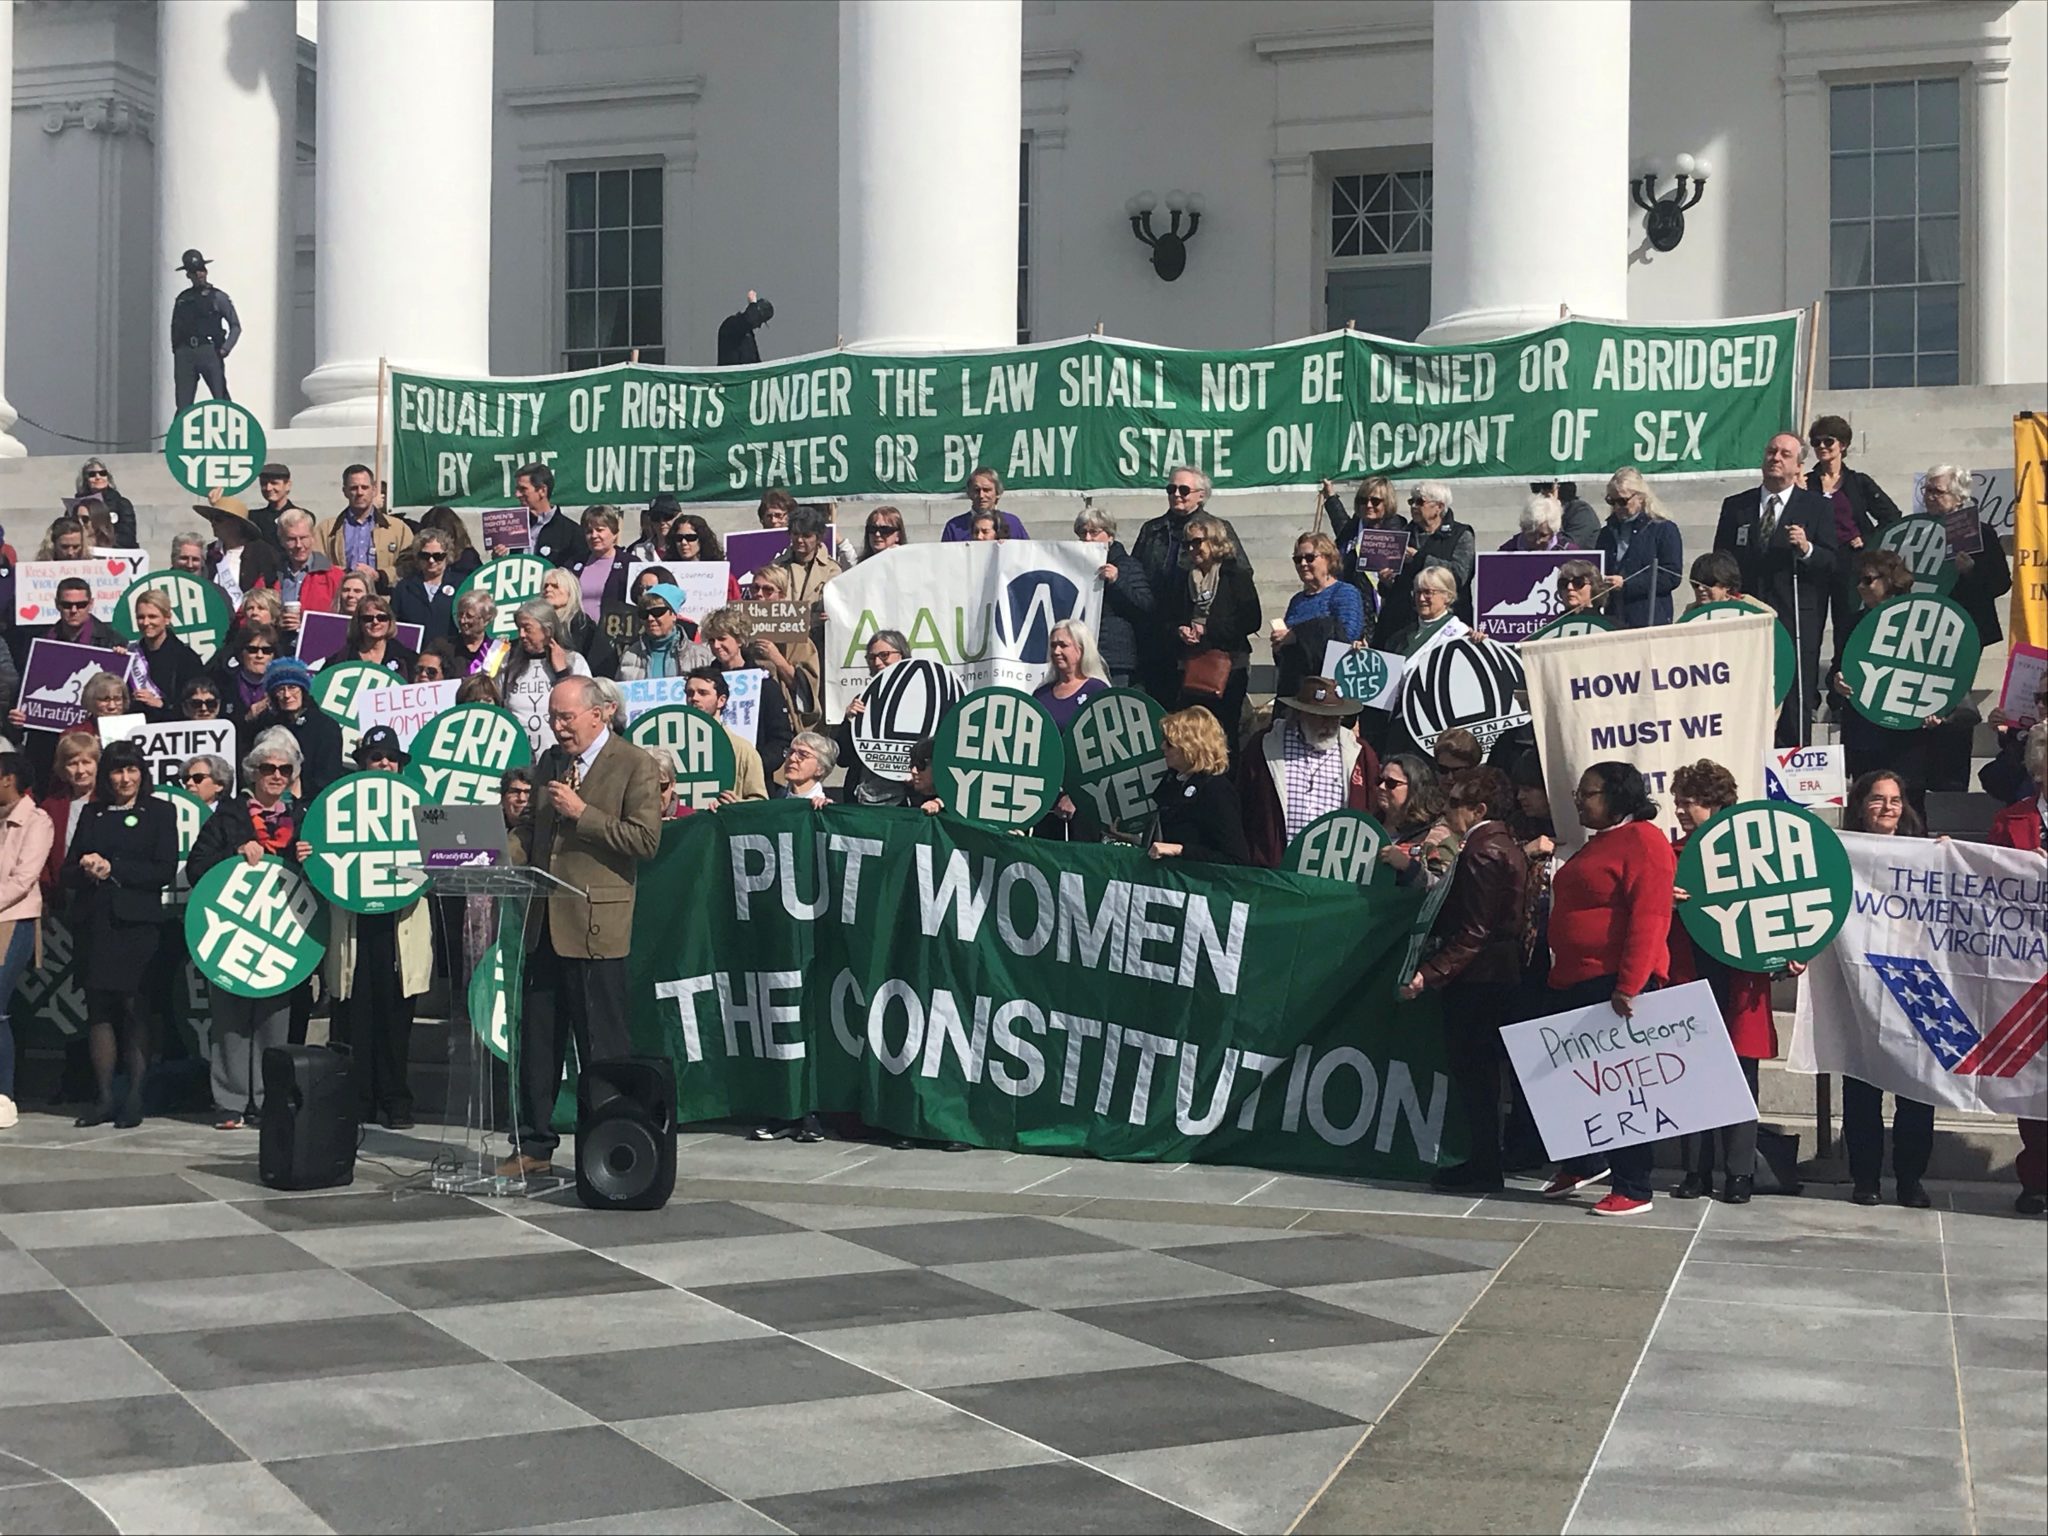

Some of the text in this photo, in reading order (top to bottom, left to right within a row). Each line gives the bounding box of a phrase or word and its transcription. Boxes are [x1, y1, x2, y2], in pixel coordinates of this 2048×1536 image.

[400, 334, 1778, 437] EQUALITY OF RIGHTS UNDER THE LAW SHALL NOT BE DENIED OR ABRIDGED
[182, 401, 248, 451] ERA
[178, 455, 254, 489] YES
[436, 451, 472, 497] BY
[586, 444, 695, 493] UNITED
[729, 434, 848, 490] STATES
[875, 433, 919, 483] OR
[944, 433, 984, 483] BY
[1007, 425, 1078, 479] ANY
[1119, 426, 1233, 478] STATE
[1266, 422, 1314, 474] ON
[1341, 413, 1514, 472] ACCOUNT
[1549, 408, 1599, 462] OF
[1633, 410, 1707, 462] SEX
[473, 558, 544, 601] ERA
[2019, 550, 2048, 567] PL
[748, 603, 768, 617] the
[771, 603, 798, 617] ERA
[750, 619, 806, 637] your seat
[1479, 618, 1548, 634] #VAratif
[1868, 599, 1965, 668] ERA
[959, 670, 989, 682] omen
[993, 669, 1032, 681] since
[1343, 650, 1382, 676] ERA
[1570, 661, 1730, 701] HOW LONG
[320, 667, 401, 721] ER
[374, 684, 442, 713] ELECT
[512, 680, 551, 694] BELIEV
[1344, 674, 1380, 700] YES
[1858, 660, 1955, 719] YES
[131, 729, 229, 757] RATIFY
[429, 708, 518, 769] ERA
[859, 741, 911, 752] NATIO
[955, 693, 1044, 767] ERA
[1072, 695, 1157, 774] ERA
[1424, 717, 1526, 747] NONAL
[1591, 713, 1723, 751] MUST WE
[865, 753, 911, 762] ORGANIZ
[419, 764, 502, 806] YES
[948, 766, 1045, 824] YES
[1080, 757, 1169, 826] YES
[1799, 780, 1822, 791] ERA
[325, 777, 420, 844] ERA
[1297, 816, 1380, 886] ERA
[1699, 808, 1818, 895] ERA
[319, 850, 429, 900] YES
[1888, 867, 1943, 895] THE
[216, 860, 319, 948] ERA
[729, 832, 1250, 995] PUT WOMEN
[1700, 887, 1833, 959] YES
[1854, 890, 1973, 926] WOMEN
[196, 906, 299, 990] YES
[1928, 927, 2048, 962] VIRGINIA
[35, 974, 89, 1035] YE
[1539, 1013, 1697, 1068] Prince George
[654, 967, 1449, 1164] THE CONSTITUTION
[1573, 1051, 1686, 1096] VOTED
[1629, 1087, 1649, 1113] 4
[1584, 1105, 1679, 1147] ERA
